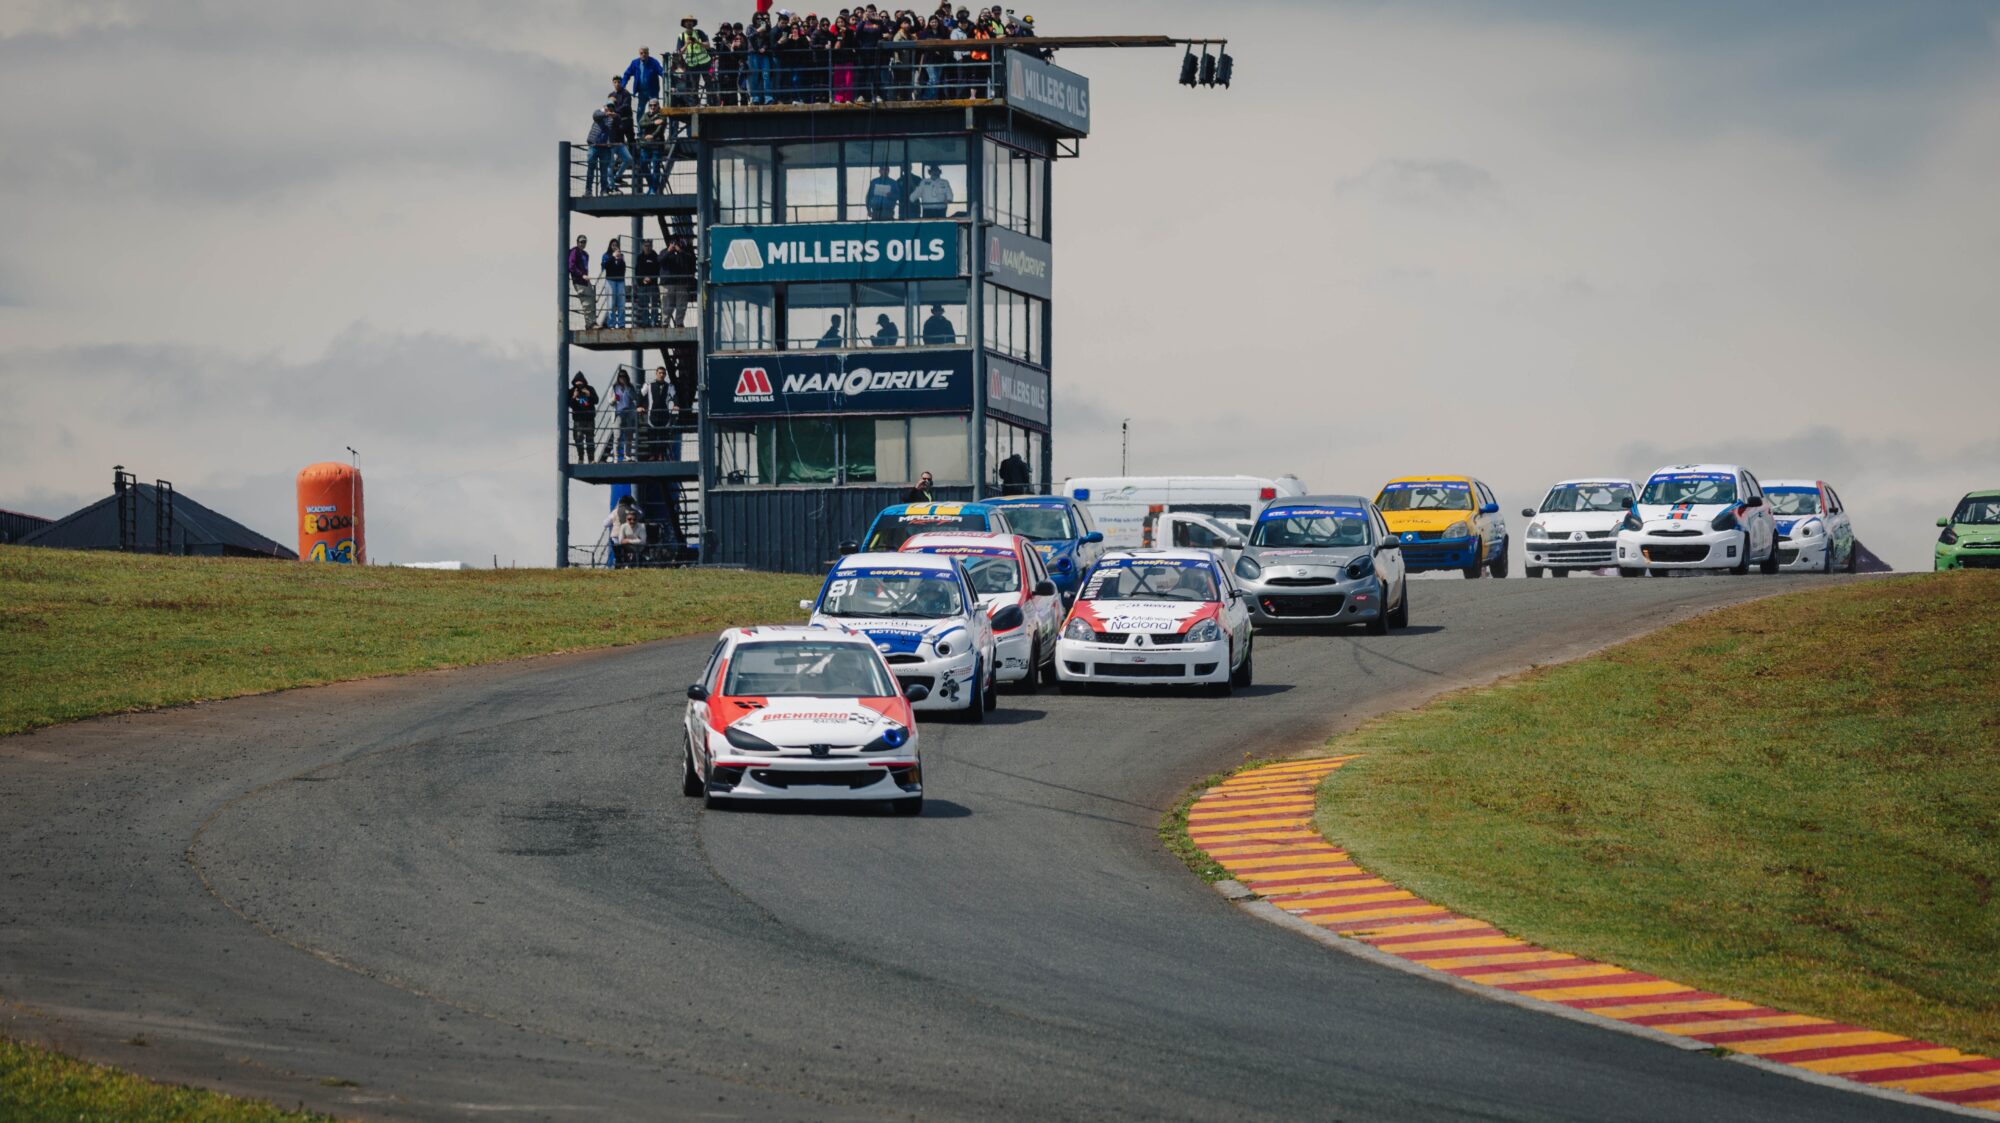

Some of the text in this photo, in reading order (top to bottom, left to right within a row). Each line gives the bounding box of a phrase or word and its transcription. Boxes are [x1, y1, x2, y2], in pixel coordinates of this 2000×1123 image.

[1025, 68, 1087, 118] MILLERS OILS
[767, 239, 945, 264] MILLERS OILS
[782, 367, 954, 396] NANODRIVE
[1001, 375, 1045, 410] MILLERS OILS
[733, 394, 775, 403] MILLERS OILS
[828, 579, 859, 598] 81
[1110, 619, 1174, 631] Nacional
[761, 712, 848, 720] BACHMANN
